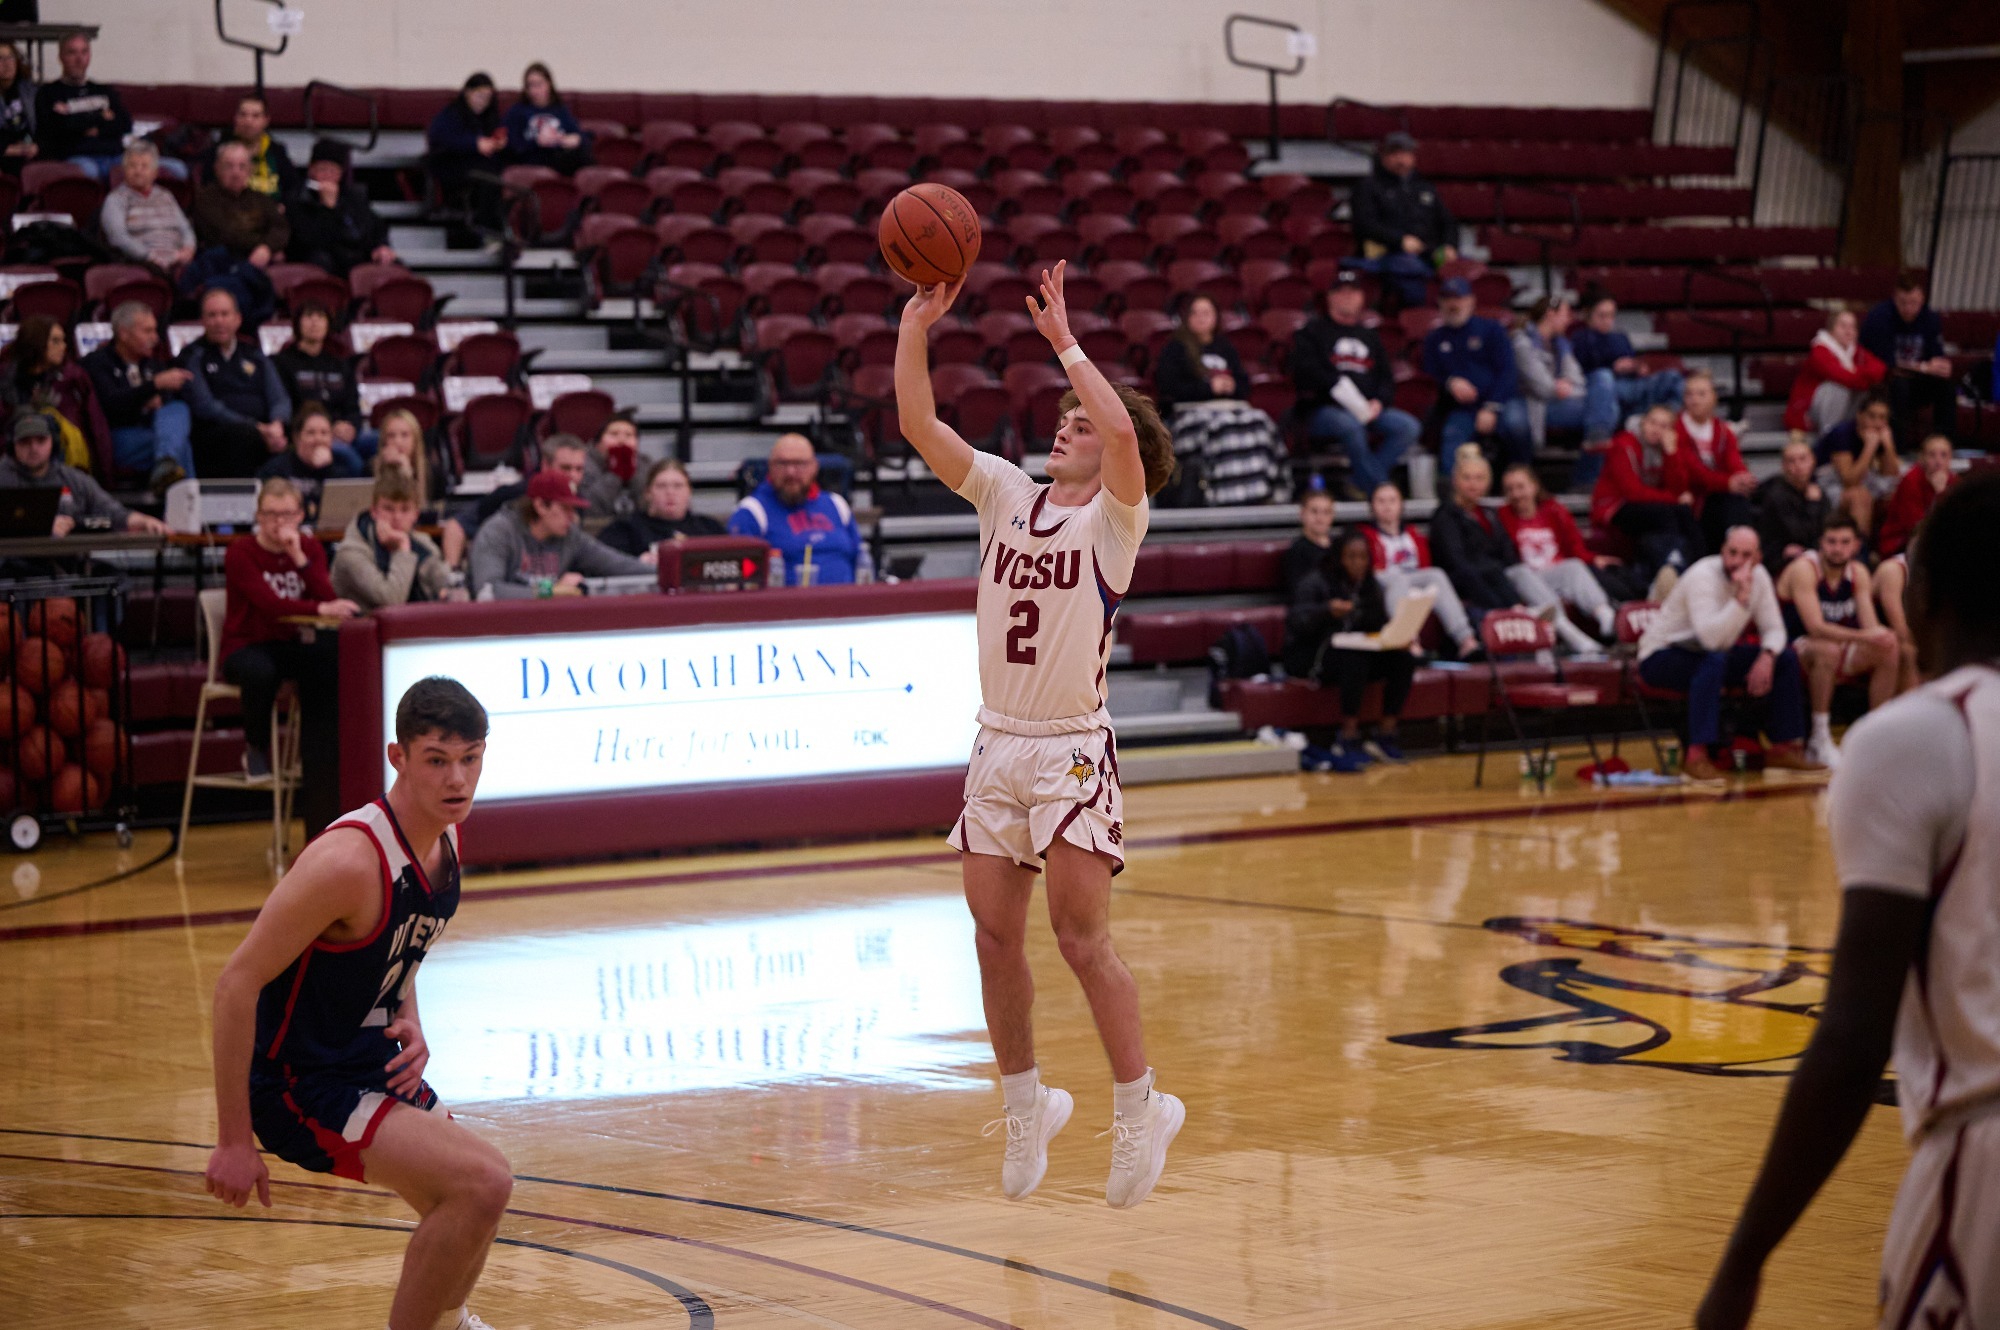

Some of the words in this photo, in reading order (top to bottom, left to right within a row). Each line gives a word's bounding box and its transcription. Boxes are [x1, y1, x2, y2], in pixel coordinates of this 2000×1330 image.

[993, 541, 1081, 590] VCSU
[1006, 599, 1040, 665] 2
[756, 643, 872, 685] BANK
[593, 727, 674, 763] Here
